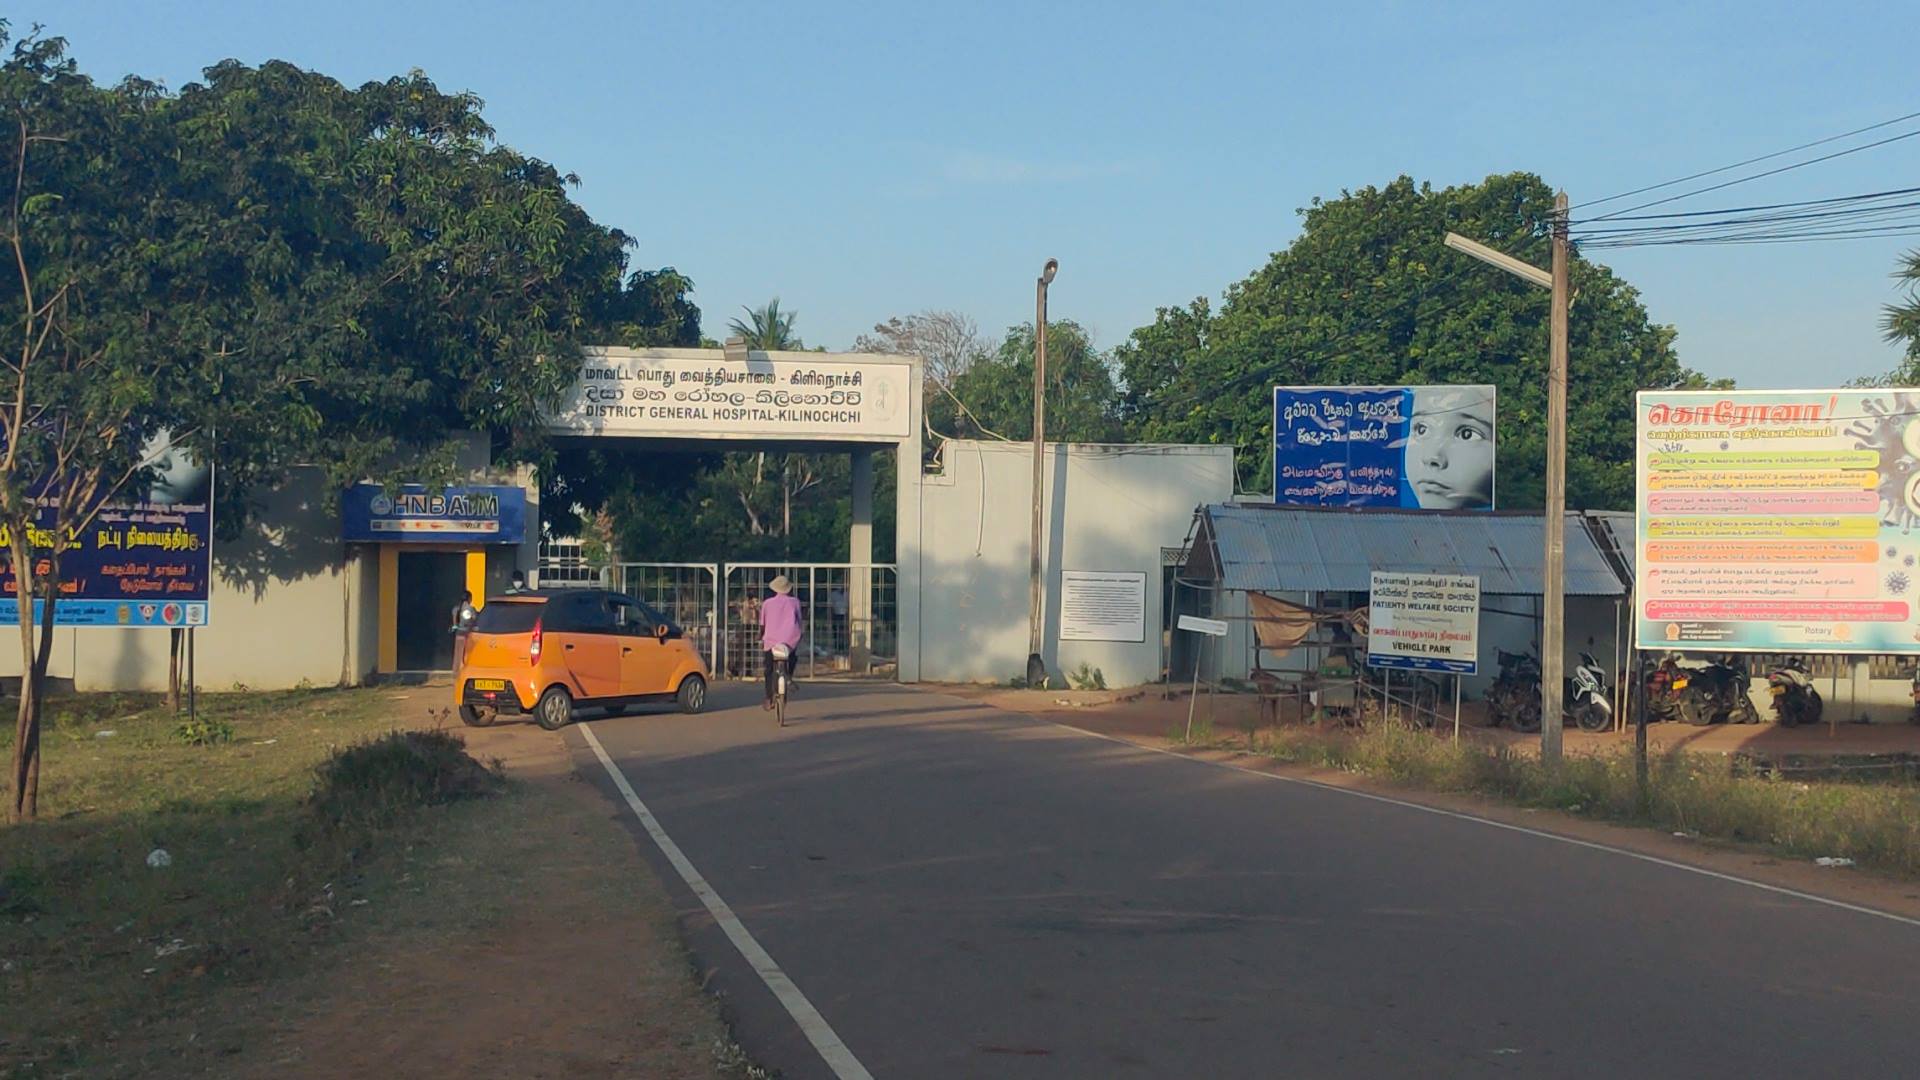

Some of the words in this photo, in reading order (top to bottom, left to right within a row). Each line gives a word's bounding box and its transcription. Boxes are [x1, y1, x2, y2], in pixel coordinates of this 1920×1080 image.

[585, 366, 633, 380] மாவட்ட
[637, 369, 675, 388] பொது
[680, 367, 776, 386] வைத்தியசாலை
[790, 369, 862, 389] கிளிநொச்சி
[632, 387, 666, 401] මහ
[585, 404, 645, 418] DISTRICT
[649, 406, 708, 419] GENERAL
[392, 494, 446, 516] HNB
[1407, 602, 1441, 611] WELFARE
[1443, 604, 1475, 613] SOCIETY
[1805, 627, 1832, 635] Rotary
[1392, 642, 1427, 652] VEHICLE
[1428, 644, 1451, 654] PARK
